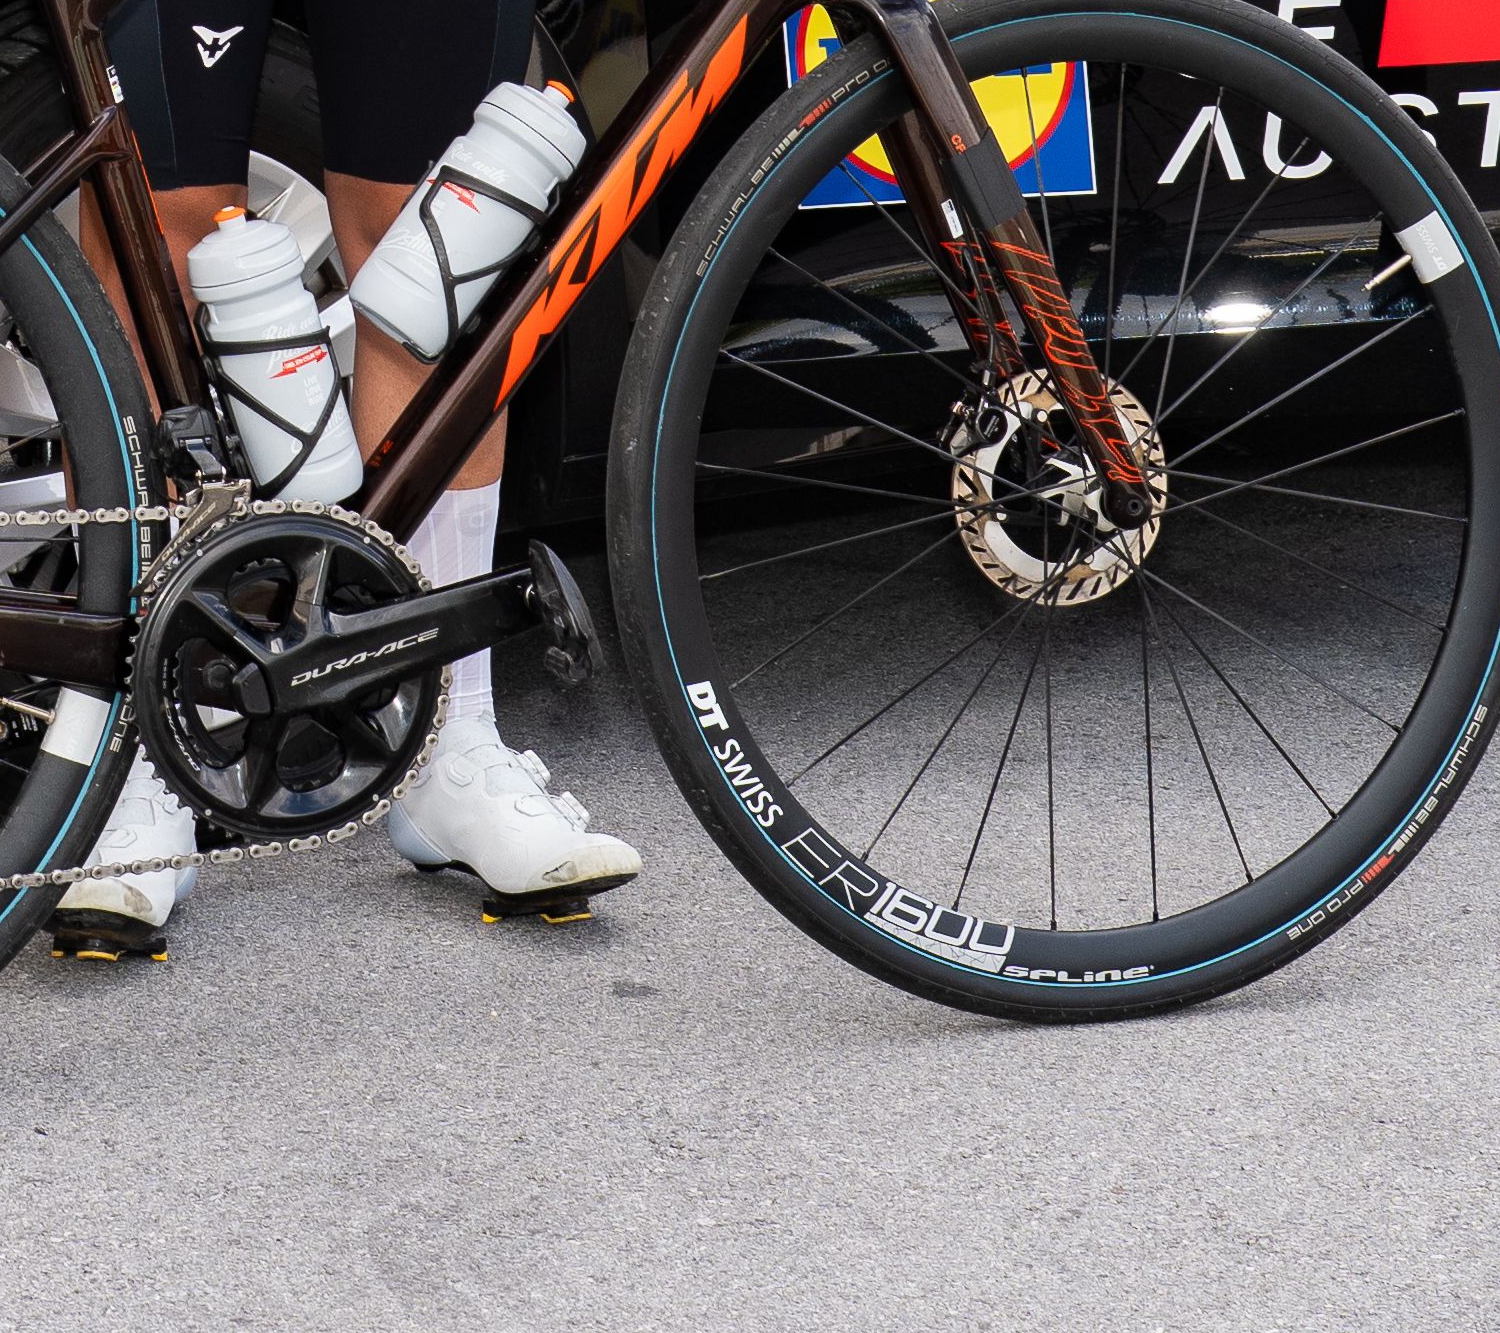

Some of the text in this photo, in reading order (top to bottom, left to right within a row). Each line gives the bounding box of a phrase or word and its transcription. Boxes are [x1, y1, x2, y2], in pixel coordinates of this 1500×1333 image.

[492, 13, 748, 413] KTM
[696, 156, 775, 277] SCHWALBE
[122, 414, 153, 564] SCHWABE
[290, 628, 440, 688] DURA-ACE
[686, 680, 784, 829] DT SWISS
[1415, 703, 1488, 825] SCHWALBE
